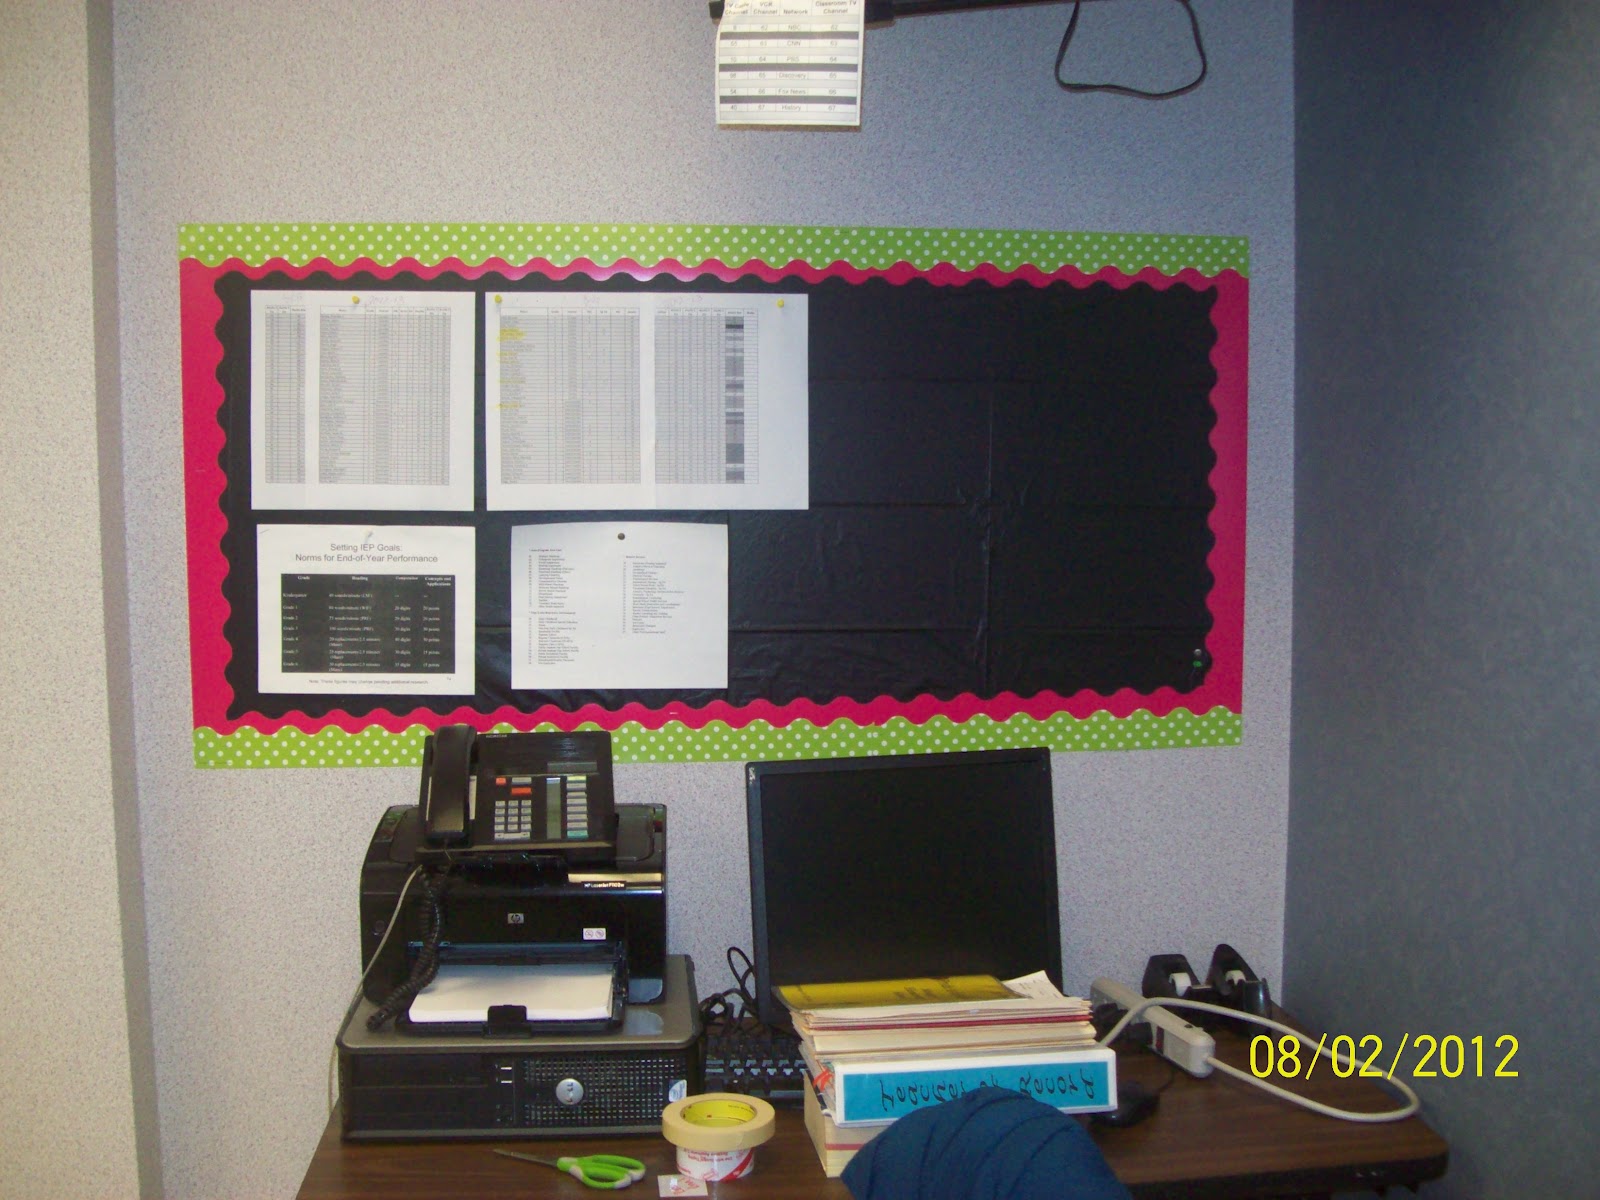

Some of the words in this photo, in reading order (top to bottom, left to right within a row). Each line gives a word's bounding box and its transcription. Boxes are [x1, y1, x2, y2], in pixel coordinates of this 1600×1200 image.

[330, 544, 358, 553] Setting
[296, 554, 322, 562] Norms
[324, 554, 336, 562] for
[337, 554, 384, 562] End-of-Year
[387, 554, 438, 562] Performance
[1019, 1068, 1094, 1100] Record
